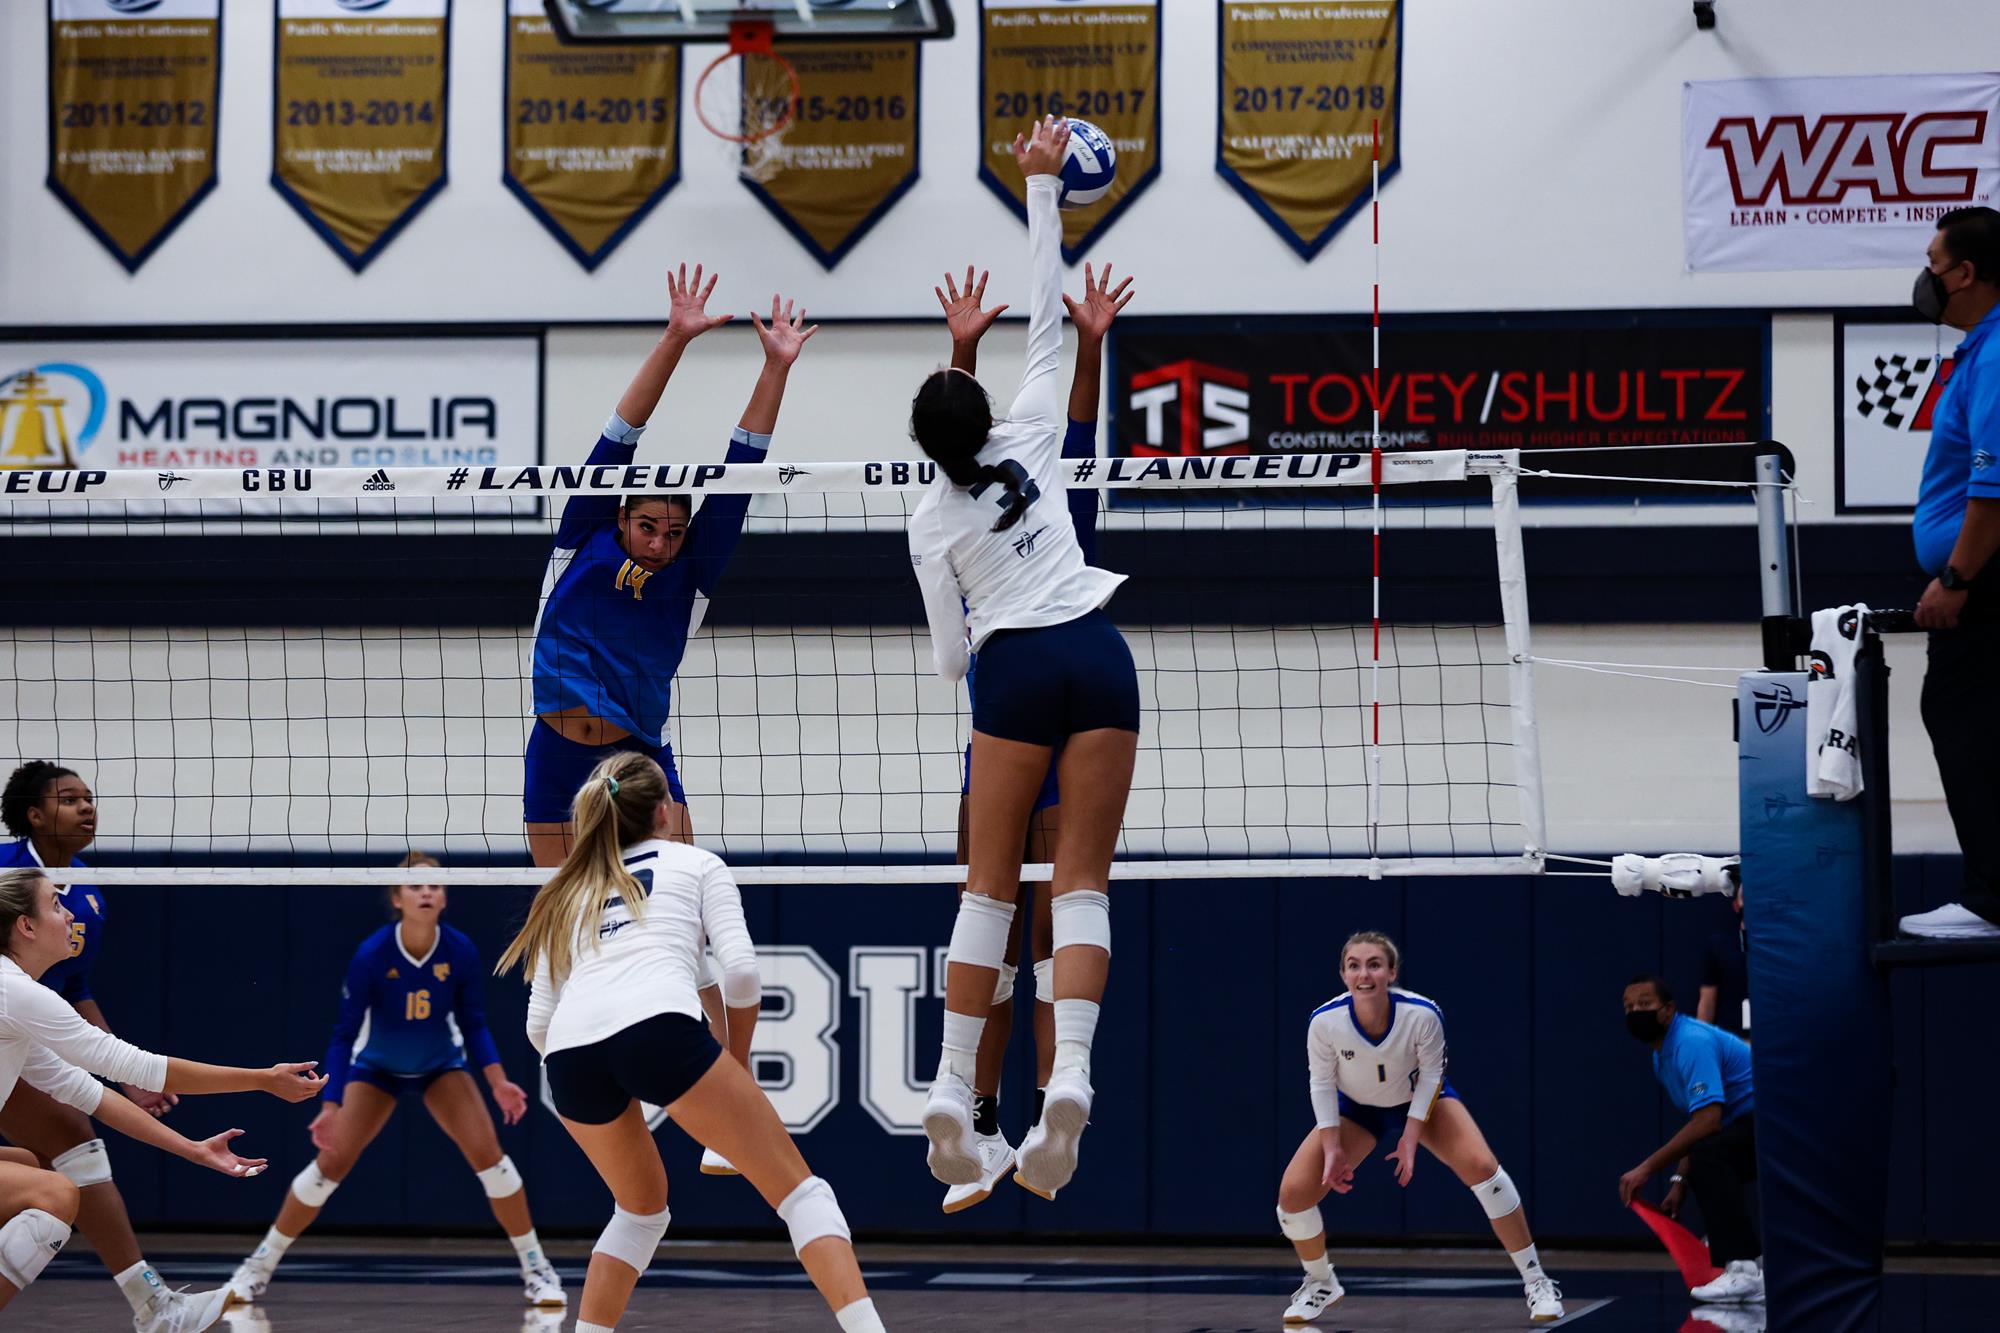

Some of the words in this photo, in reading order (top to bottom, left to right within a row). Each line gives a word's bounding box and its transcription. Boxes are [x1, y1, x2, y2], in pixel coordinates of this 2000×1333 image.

[519, 98, 669, 124] 2014-2015
[994, 89, 1146, 118] 2016-2017
[1233, 85, 1384, 112] 2017-2018
[63, 101, 206, 128] 2011-2012
[287, 100, 434, 126] 2013-2014
[1706, 111, 1988, 207] WAC
[1730, 209, 1787, 227] LEARN
[1806, 207, 1887, 224] COMPETE
[1906, 204, 1974, 221] INSP
[119, 397, 497, 441] MAGNOLIA
[1268, 430, 1405, 449] CONSTRUCTON
[1437, 431, 1524, 448] BUILDING
[1529, 429, 1601, 446] HIGHER
[1607, 427, 1747, 444] EXPECTATIONS
[118, 448, 257, 466] HEATING
[272, 448, 339, 466] AND
[0, 471, 107, 493] EUP
[243, 469, 312, 492] CBU
[362, 482, 396, 491] adidas
[865, 462, 935, 486] CBU
[615, 558, 654, 601] 14
[405, 989, 431, 1020] 16
[541, 945, 955, 1136] BU
[1377, 1064, 1386, 1083] 1
